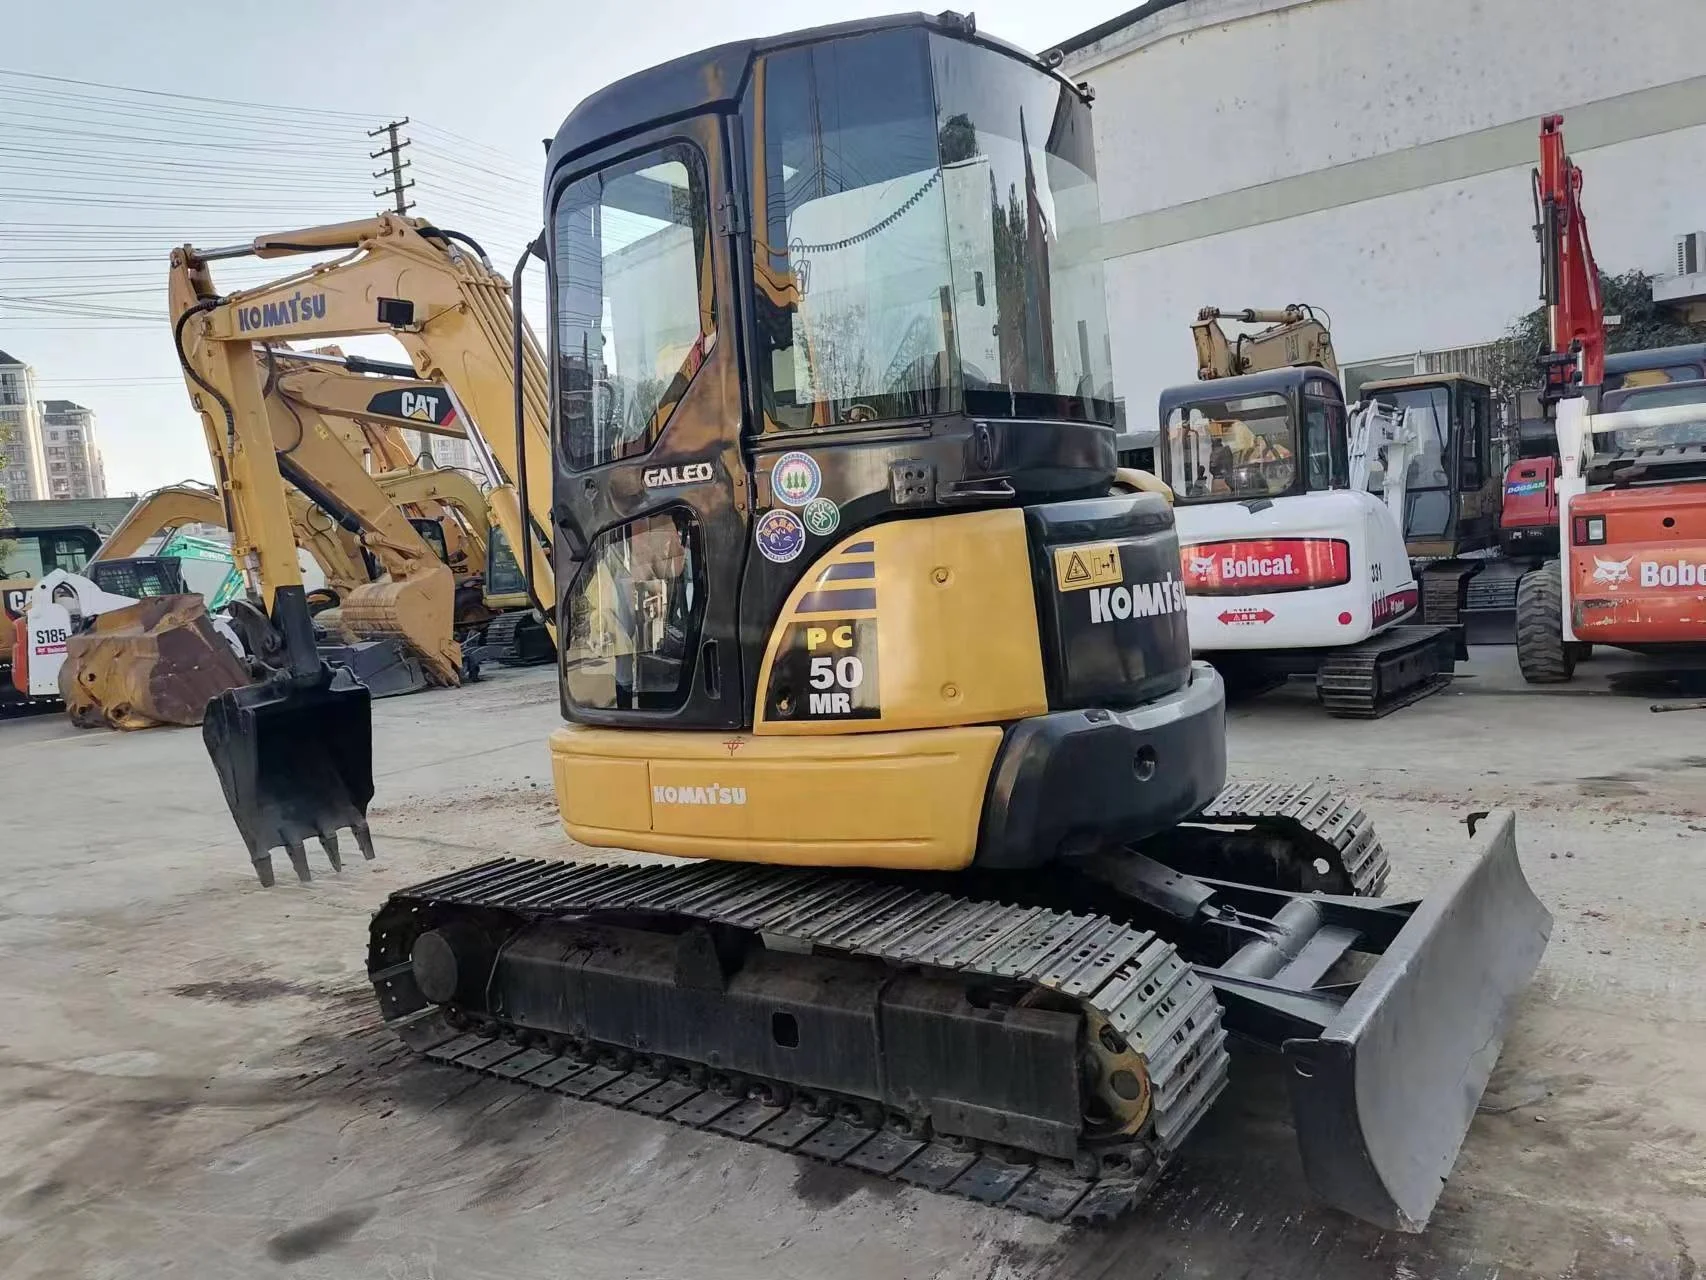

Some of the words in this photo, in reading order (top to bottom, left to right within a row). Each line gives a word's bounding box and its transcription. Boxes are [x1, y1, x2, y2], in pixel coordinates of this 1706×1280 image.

[238, 291, 326, 332] KOMATSU
[401, 391, 439, 422] CAT
[643, 462, 713, 488] GALEO
[1507, 481, 1546, 494] DOOSAN
[1222, 554, 1293, 579] Bobcat
[36, 628, 67, 644] S185
[807, 625, 853, 650] PC
[809, 656, 864, 690] 50
[809, 693, 851, 714] MR
[653, 782, 747, 805] KOMATSU
